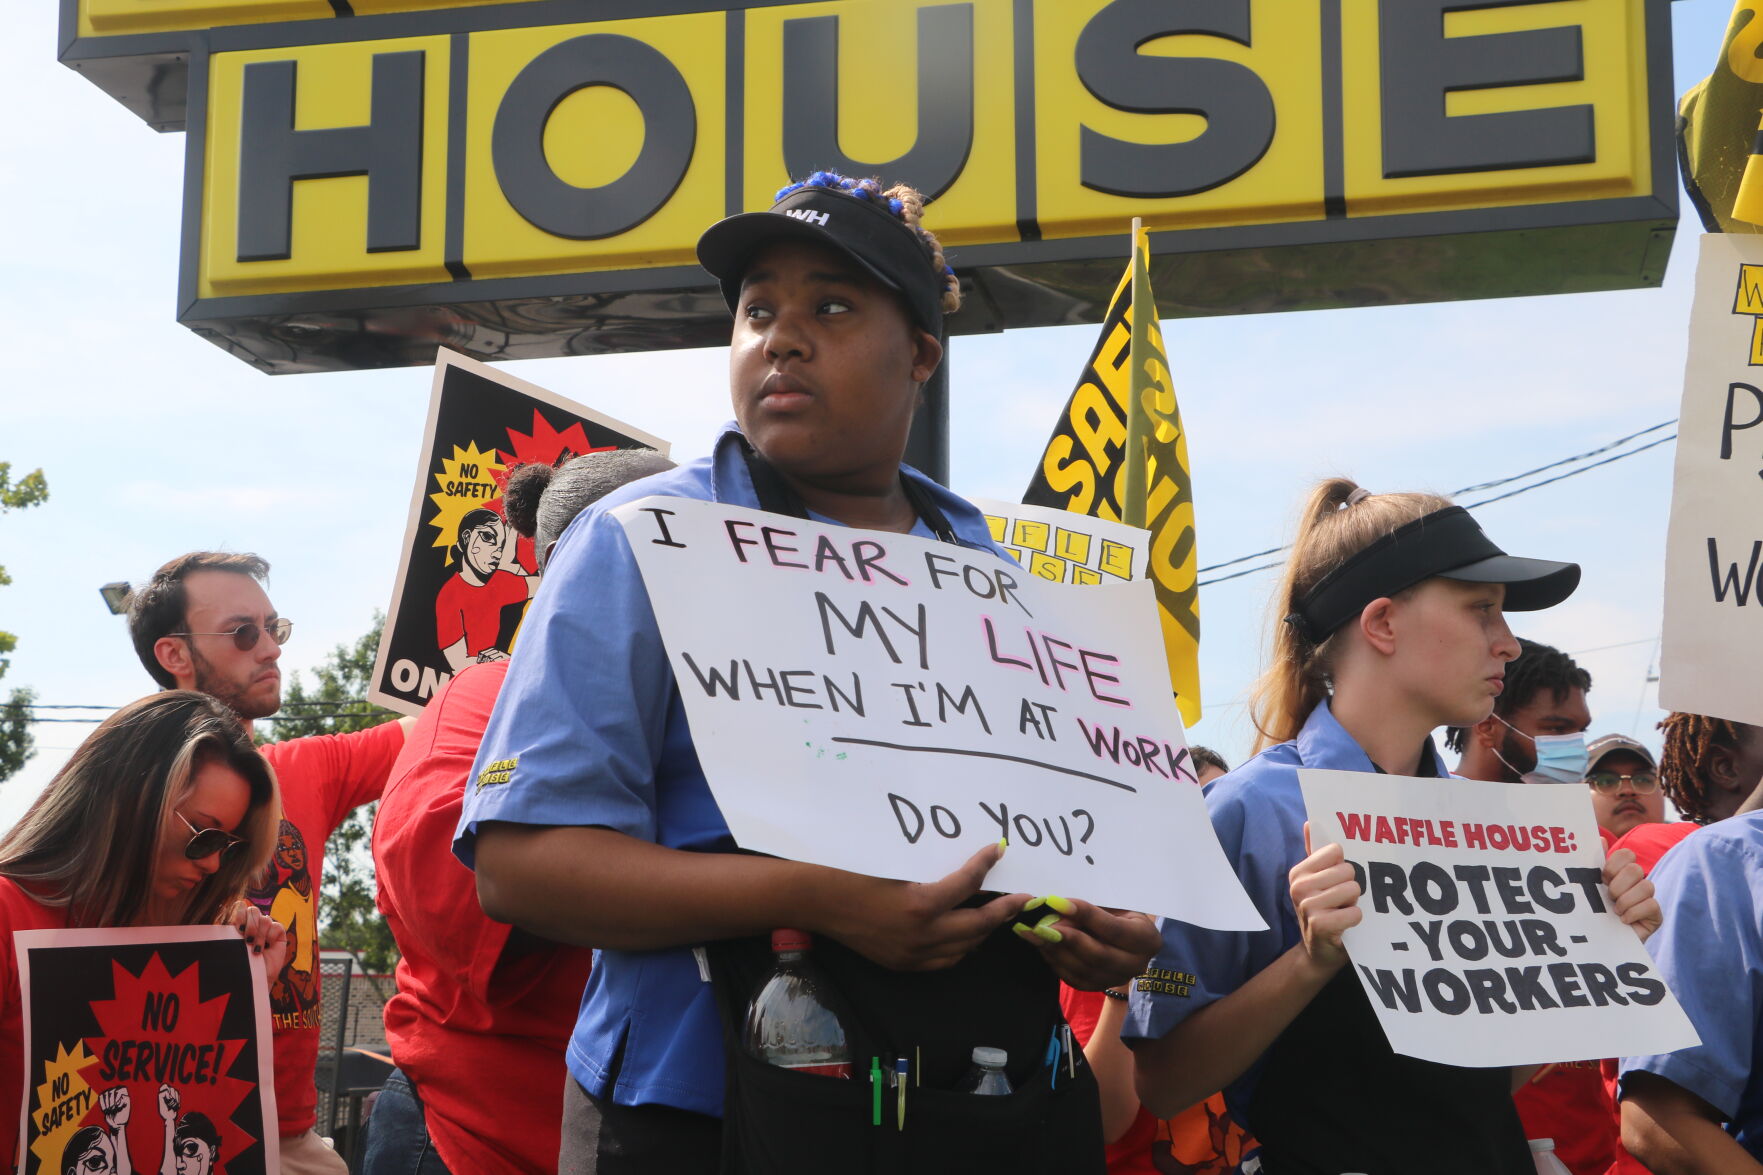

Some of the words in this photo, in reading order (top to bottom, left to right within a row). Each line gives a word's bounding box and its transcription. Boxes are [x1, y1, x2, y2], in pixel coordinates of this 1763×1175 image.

[237, 0, 1596, 262] HOUSE
[786, 209, 830, 227] WH
[444, 481, 498, 499] SAFETY
[460, 463, 478, 479] NO
[639, 508, 687, 548] I
[724, 519, 909, 587] FEAR
[925, 551, 1033, 618] FOR
[815, 591, 929, 670] MY
[983, 616, 1132, 707] LIFE
[681, 651, 866, 718] WHEN
[891, 681, 992, 736] I'M
[1020, 697, 1059, 742] AT
[1076, 717, 1199, 785] WORK
[887, 792, 962, 844] DO
[978, 800, 1095, 867] YOU?
[1335, 811, 1458, 848] WAFFLE
[1462, 822, 1578, 854] HOUSE:
[141, 991, 180, 1033] NO
[1357, 961, 1667, 1016] WORKERS
[272, 1011, 300, 1030] THE
[99, 1039, 226, 1086] SERVICE!
[52, 1072, 70, 1103] NO
[41, 1087, 91, 1137] SAFETY
